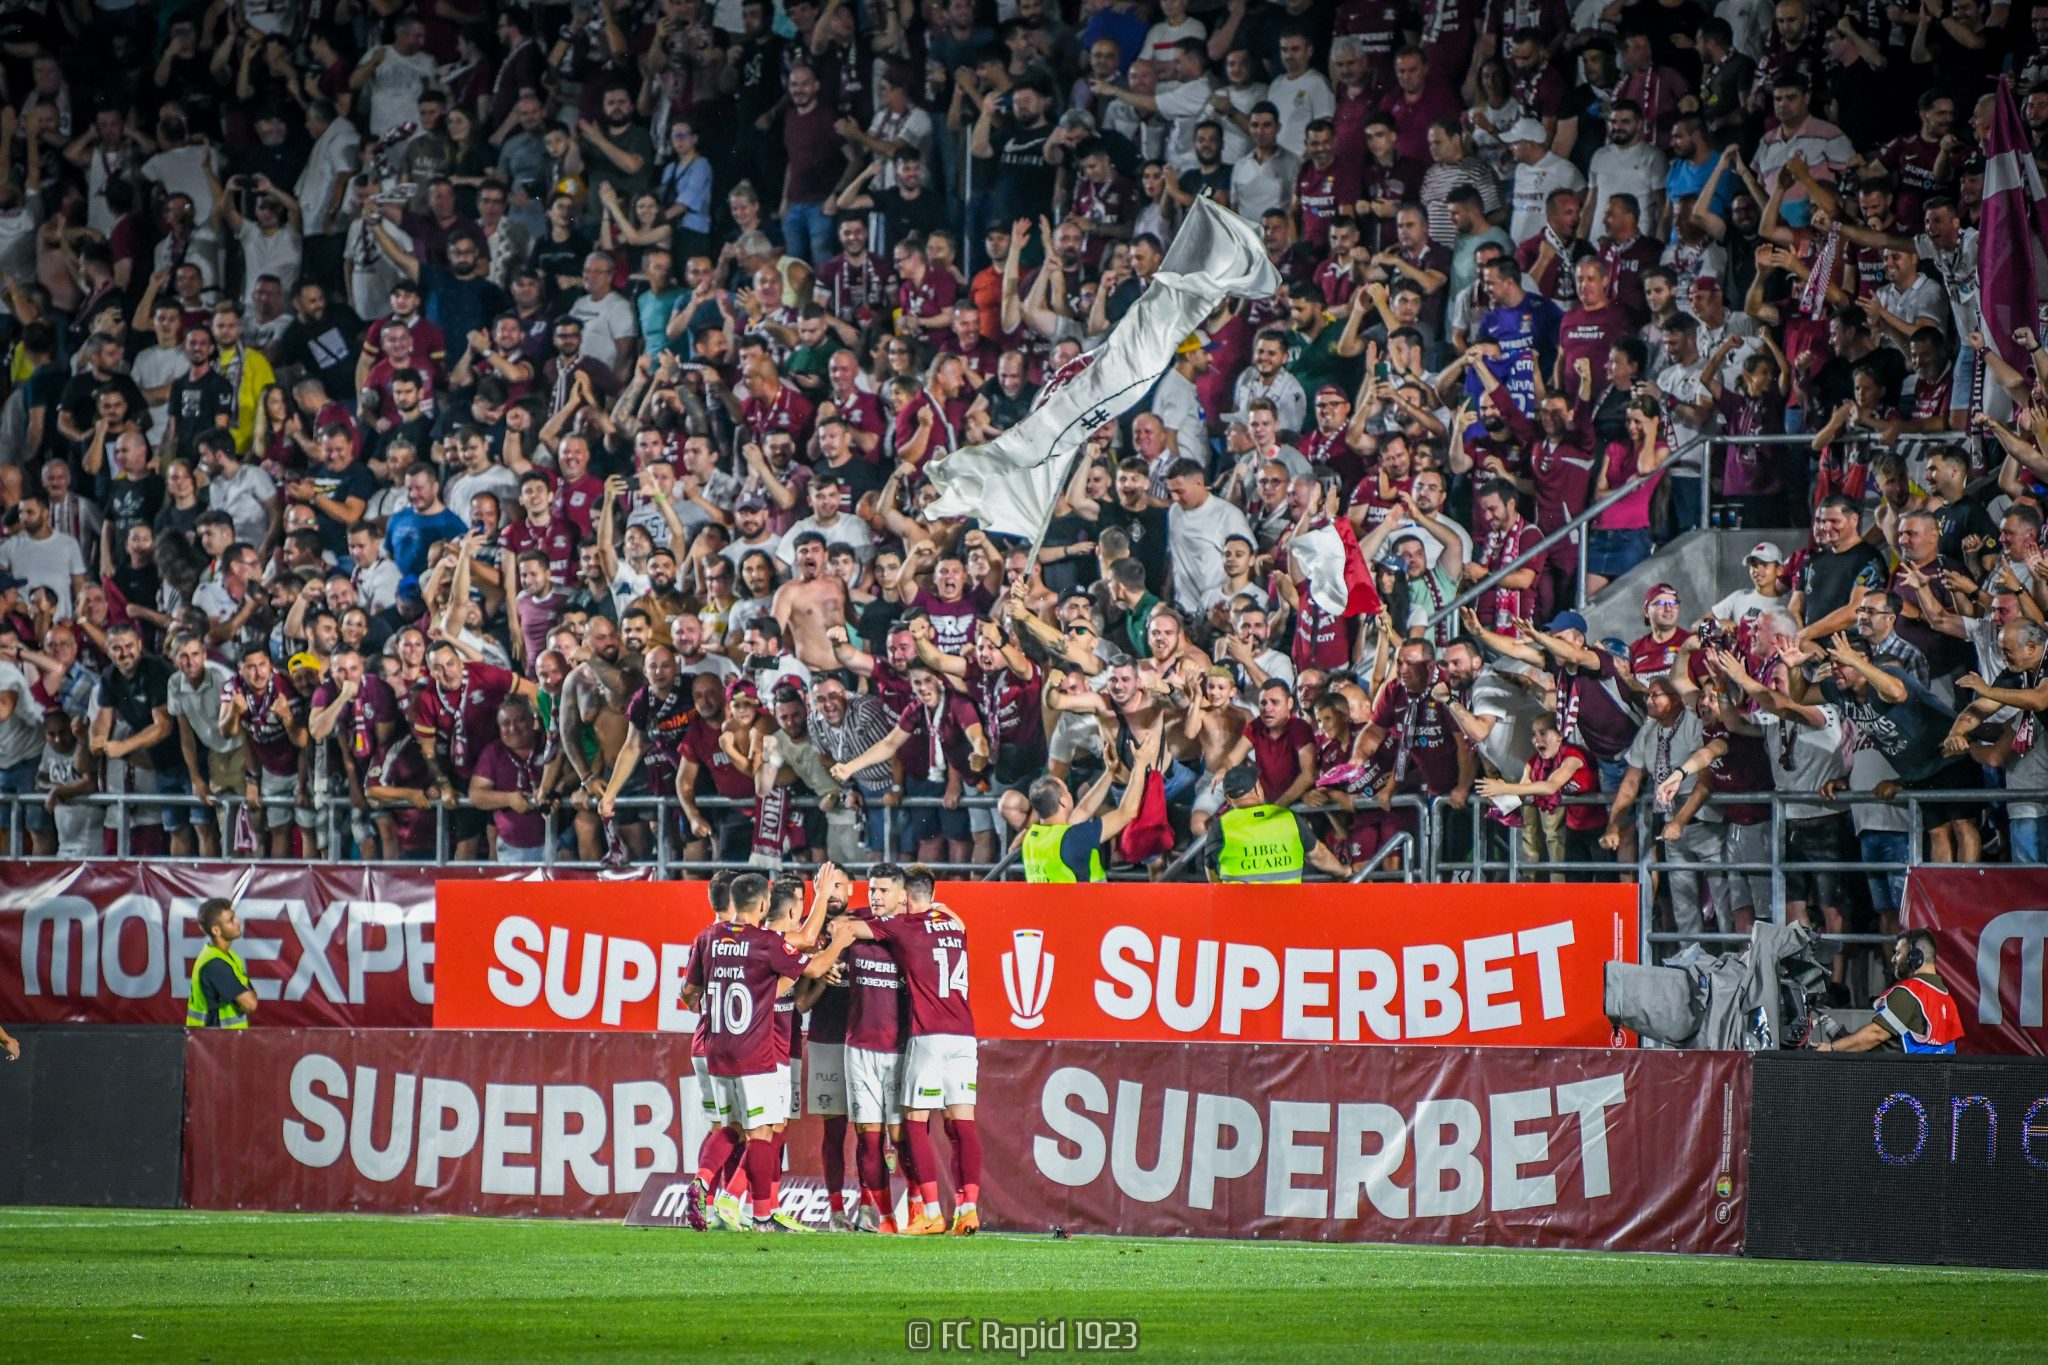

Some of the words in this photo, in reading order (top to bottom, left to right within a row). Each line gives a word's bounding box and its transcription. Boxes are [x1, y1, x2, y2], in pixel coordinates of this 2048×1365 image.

[1904, 164, 1935, 181] SUPER
[1858, 261, 1885, 271] SUPER
[712, 752, 731, 766] PU
[760, 785, 784, 841] FORZ
[1243, 843, 1288, 857] LIBRA
[1240, 855, 1292, 871] GUARD
[924, 919, 962, 934] Ferrol
[488, 915, 702, 1034] SUPE
[932, 947, 968, 1001] 14
[1094, 920, 1576, 1041] SUPERBET
[708, 981, 753, 1035] 10
[815, 1072, 838, 1082] PLUS
[850, 1082, 868, 1092] PLU
[283, 1054, 698, 1195] SUPERB
[1034, 1066, 1627, 1220] SUPERBET
